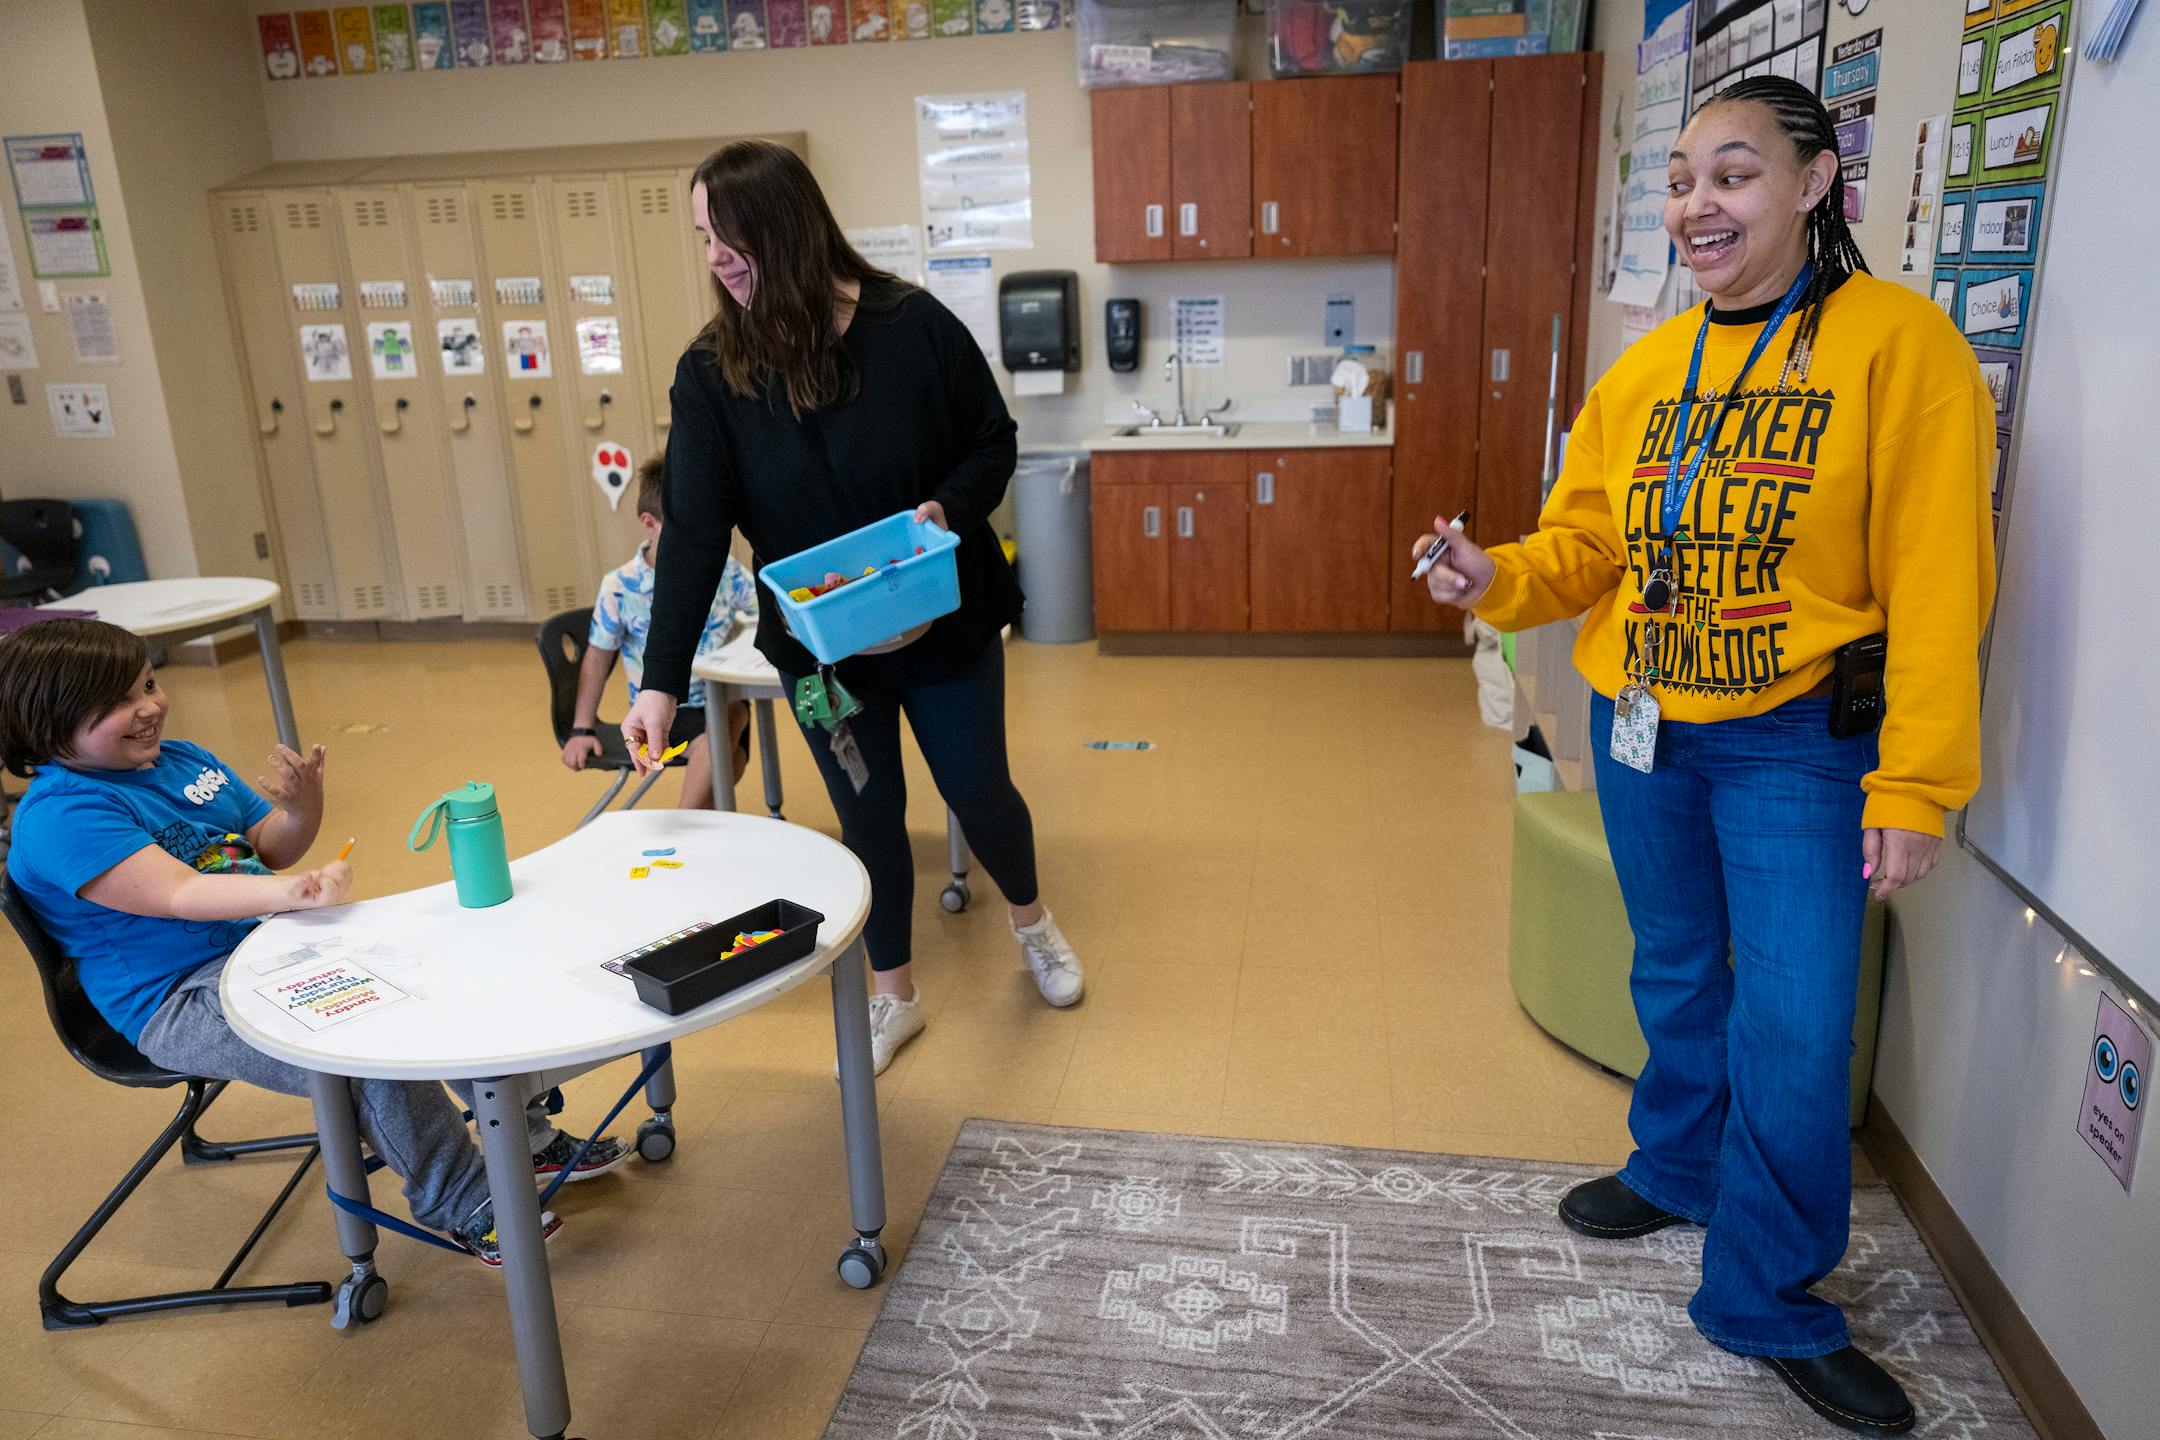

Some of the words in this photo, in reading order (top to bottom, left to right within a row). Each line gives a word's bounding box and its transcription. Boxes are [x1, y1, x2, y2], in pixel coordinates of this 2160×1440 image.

[1962, 59, 1980, 77] 11:45
[1997, 58, 2012, 75] Fun
[2012, 49, 2036, 69] Friday
[1833, 64, 1869, 88] Thursday
[1840, 104, 1855, 120] Today
[1855, 103, 1861, 115] is
[1990, 132, 2014, 151] Lunch
[1943, 221, 1962, 236] 12:45
[1979, 221, 2004, 234] Indoor
[1971, 300, 1998, 317] Choice
[1636, 398, 1833, 465] BLACKER
[1682, 596, 1720, 627] THE
[1624, 619, 1791, 686] KNOWLEDGE
[277, 967, 346, 993] Saturday
[290, 976, 359, 1002] Thursday
[295, 975, 343, 993] Friday
[288, 977, 374, 1010] Wednesday
[315, 990, 376, 1013] Monday
[325, 995, 380, 1017] Sunday
[2093, 1105, 2113, 1130] eyes
[2114, 1128, 2125, 1144] on
[2090, 1124, 2122, 1163] speaker
